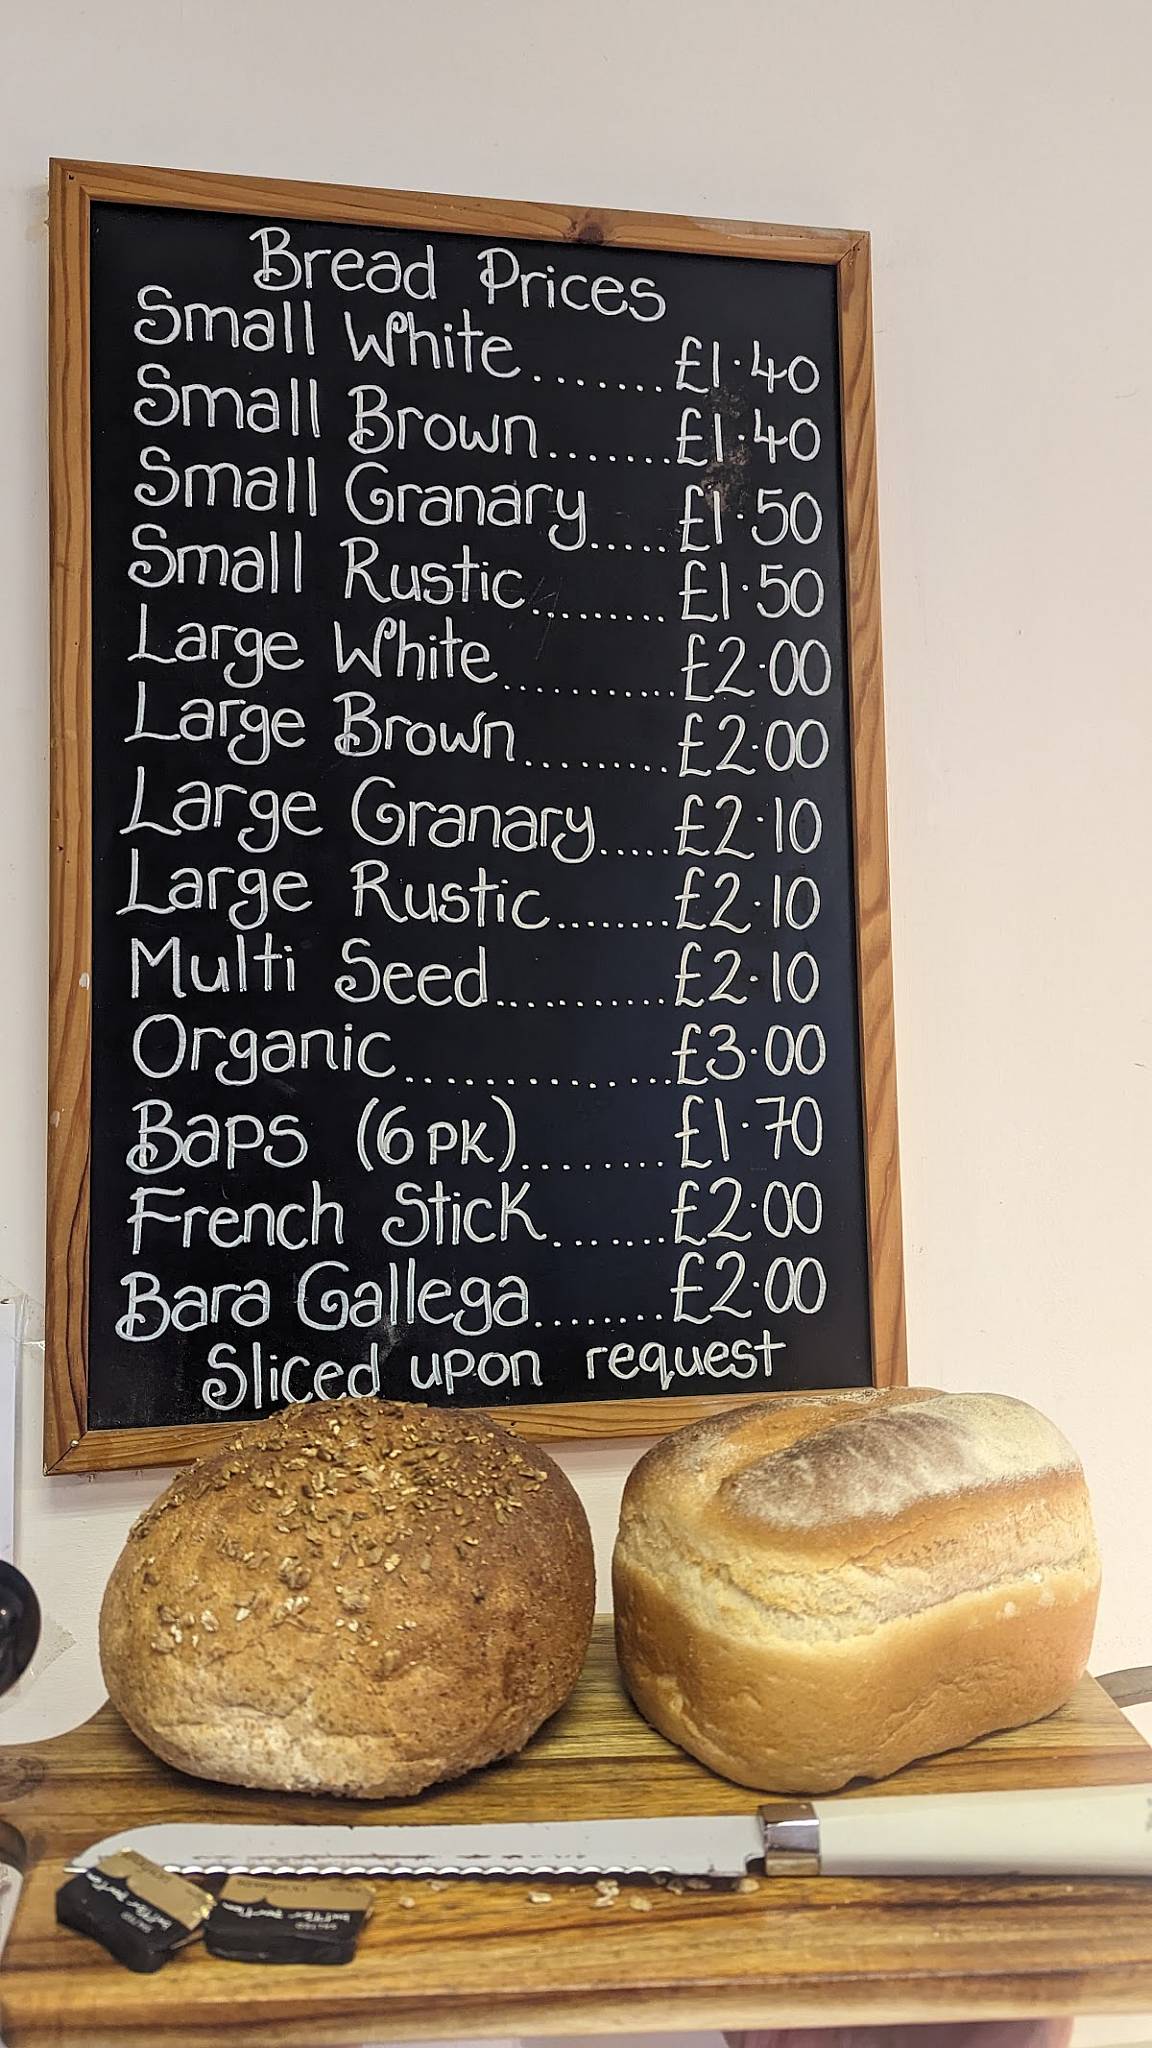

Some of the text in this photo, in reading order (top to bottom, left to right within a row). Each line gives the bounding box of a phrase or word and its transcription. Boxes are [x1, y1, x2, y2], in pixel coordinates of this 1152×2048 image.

[248, 226, 666, 322] Bread Prices
[133, 284, 315, 356] Small
[343, 308, 522, 378] White
[133, 362, 321, 438] Small
[347, 384, 538, 459] Brown
[134, 445, 317, 517] Small
[345, 461, 587, 552] Granary
[127, 523, 302, 594] Small
[339, 536, 526, 609] Rustic
[127, 602, 305, 689] Large
[333, 616, 498, 684] White
[123, 680, 306, 766] Large
[332, 691, 515, 762] Brown
[119, 765, 324, 853] Large
[351, 775, 596, 864] Granary
[115, 847, 313, 931] Large
[349, 859, 551, 930] Rustic
[131, 932, 295, 999] Multi
[334, 937, 488, 1008] Seed
[132, 1013, 396, 1087] Organic
[125, 1099, 309, 1175] Baps
[126, 1180, 344, 1255] French
[114, 1271, 271, 1342] Bara
[296, 1257, 529, 1337] Gallega
[201, 1329, 787, 1412] Sliced upon request
